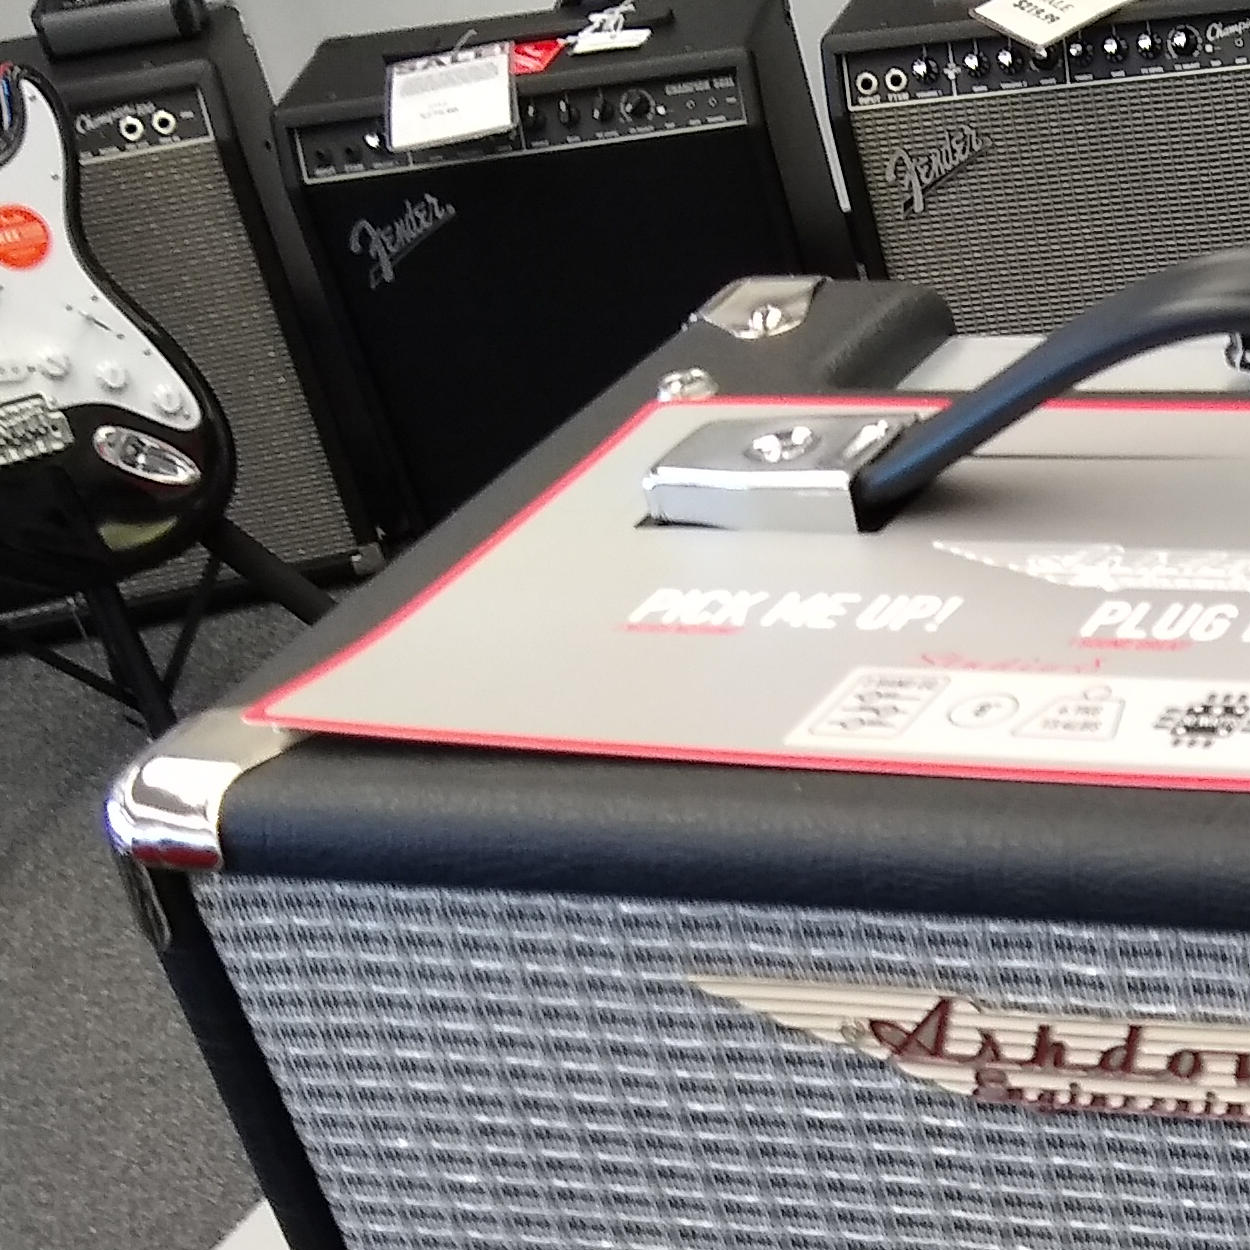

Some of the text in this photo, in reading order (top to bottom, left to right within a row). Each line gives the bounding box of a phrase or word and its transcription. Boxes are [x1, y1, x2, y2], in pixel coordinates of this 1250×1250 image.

[885, 124, 993, 220] Fender
[349, 192, 457, 289] Fender
[628, 587, 965, 632] PICK ME UP!
[1080, 600, 1240, 642] PLUG
